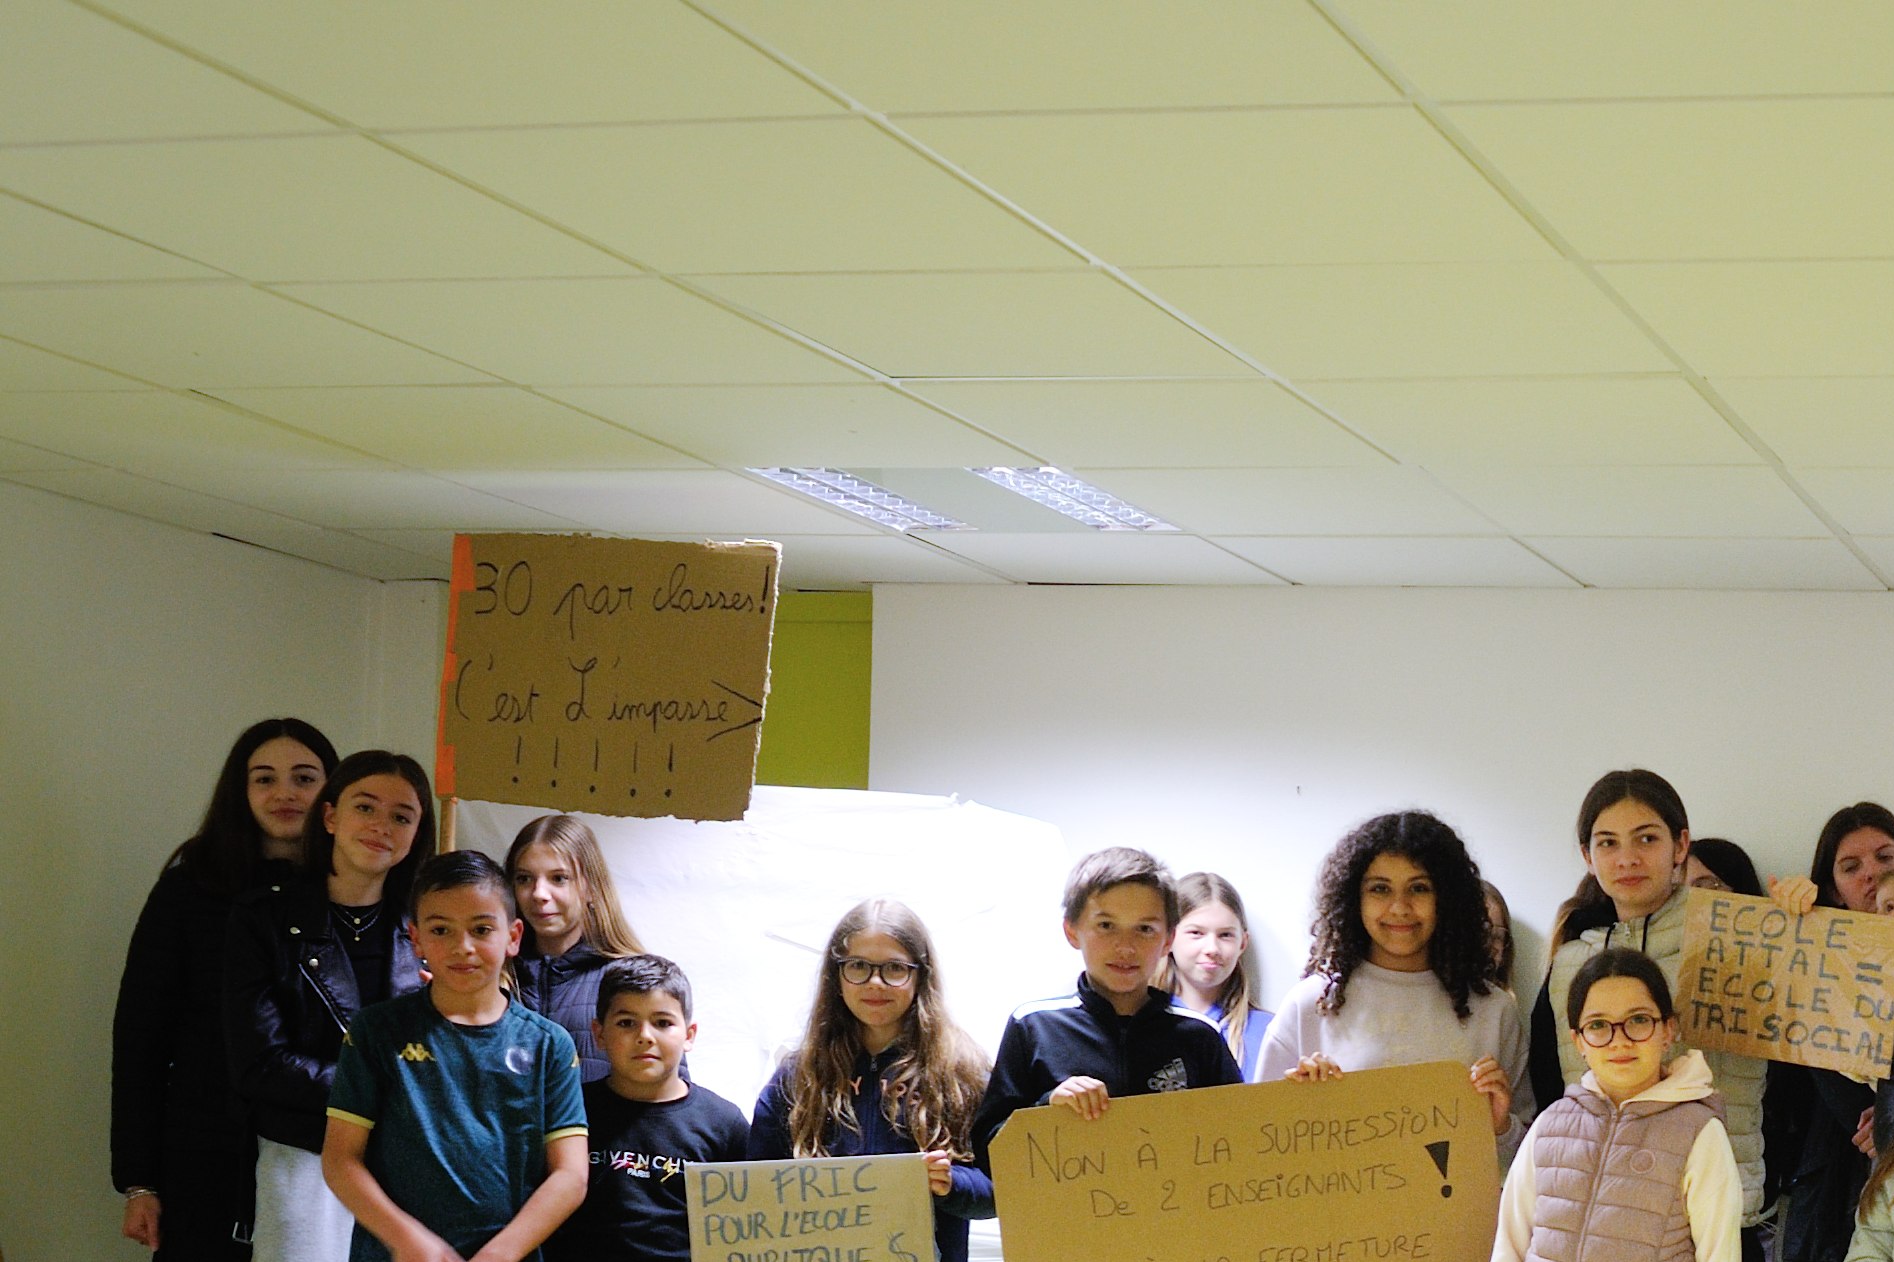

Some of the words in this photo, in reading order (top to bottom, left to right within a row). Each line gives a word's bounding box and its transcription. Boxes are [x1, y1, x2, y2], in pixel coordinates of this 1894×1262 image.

[474, 561, 532, 616] 30
[553, 583, 634, 641] par
[1709, 899, 1854, 950] ECOLE
[1705, 935, 1840, 981] ATTAL
[1699, 966, 1832, 1014] ECOLE
[1690, 999, 1748, 1035] TRI
[1756, 1012, 1892, 1066] SOCIAL
[1137, 1128, 1158, 1170] À
[1194, 1134, 1232, 1165] LA
[700, 1169, 749, 1208] DU
[771, 1162, 878, 1203] FRIC
[1160, 1179, 1181, 1211] 2
[704, 1211, 774, 1246] POUR
